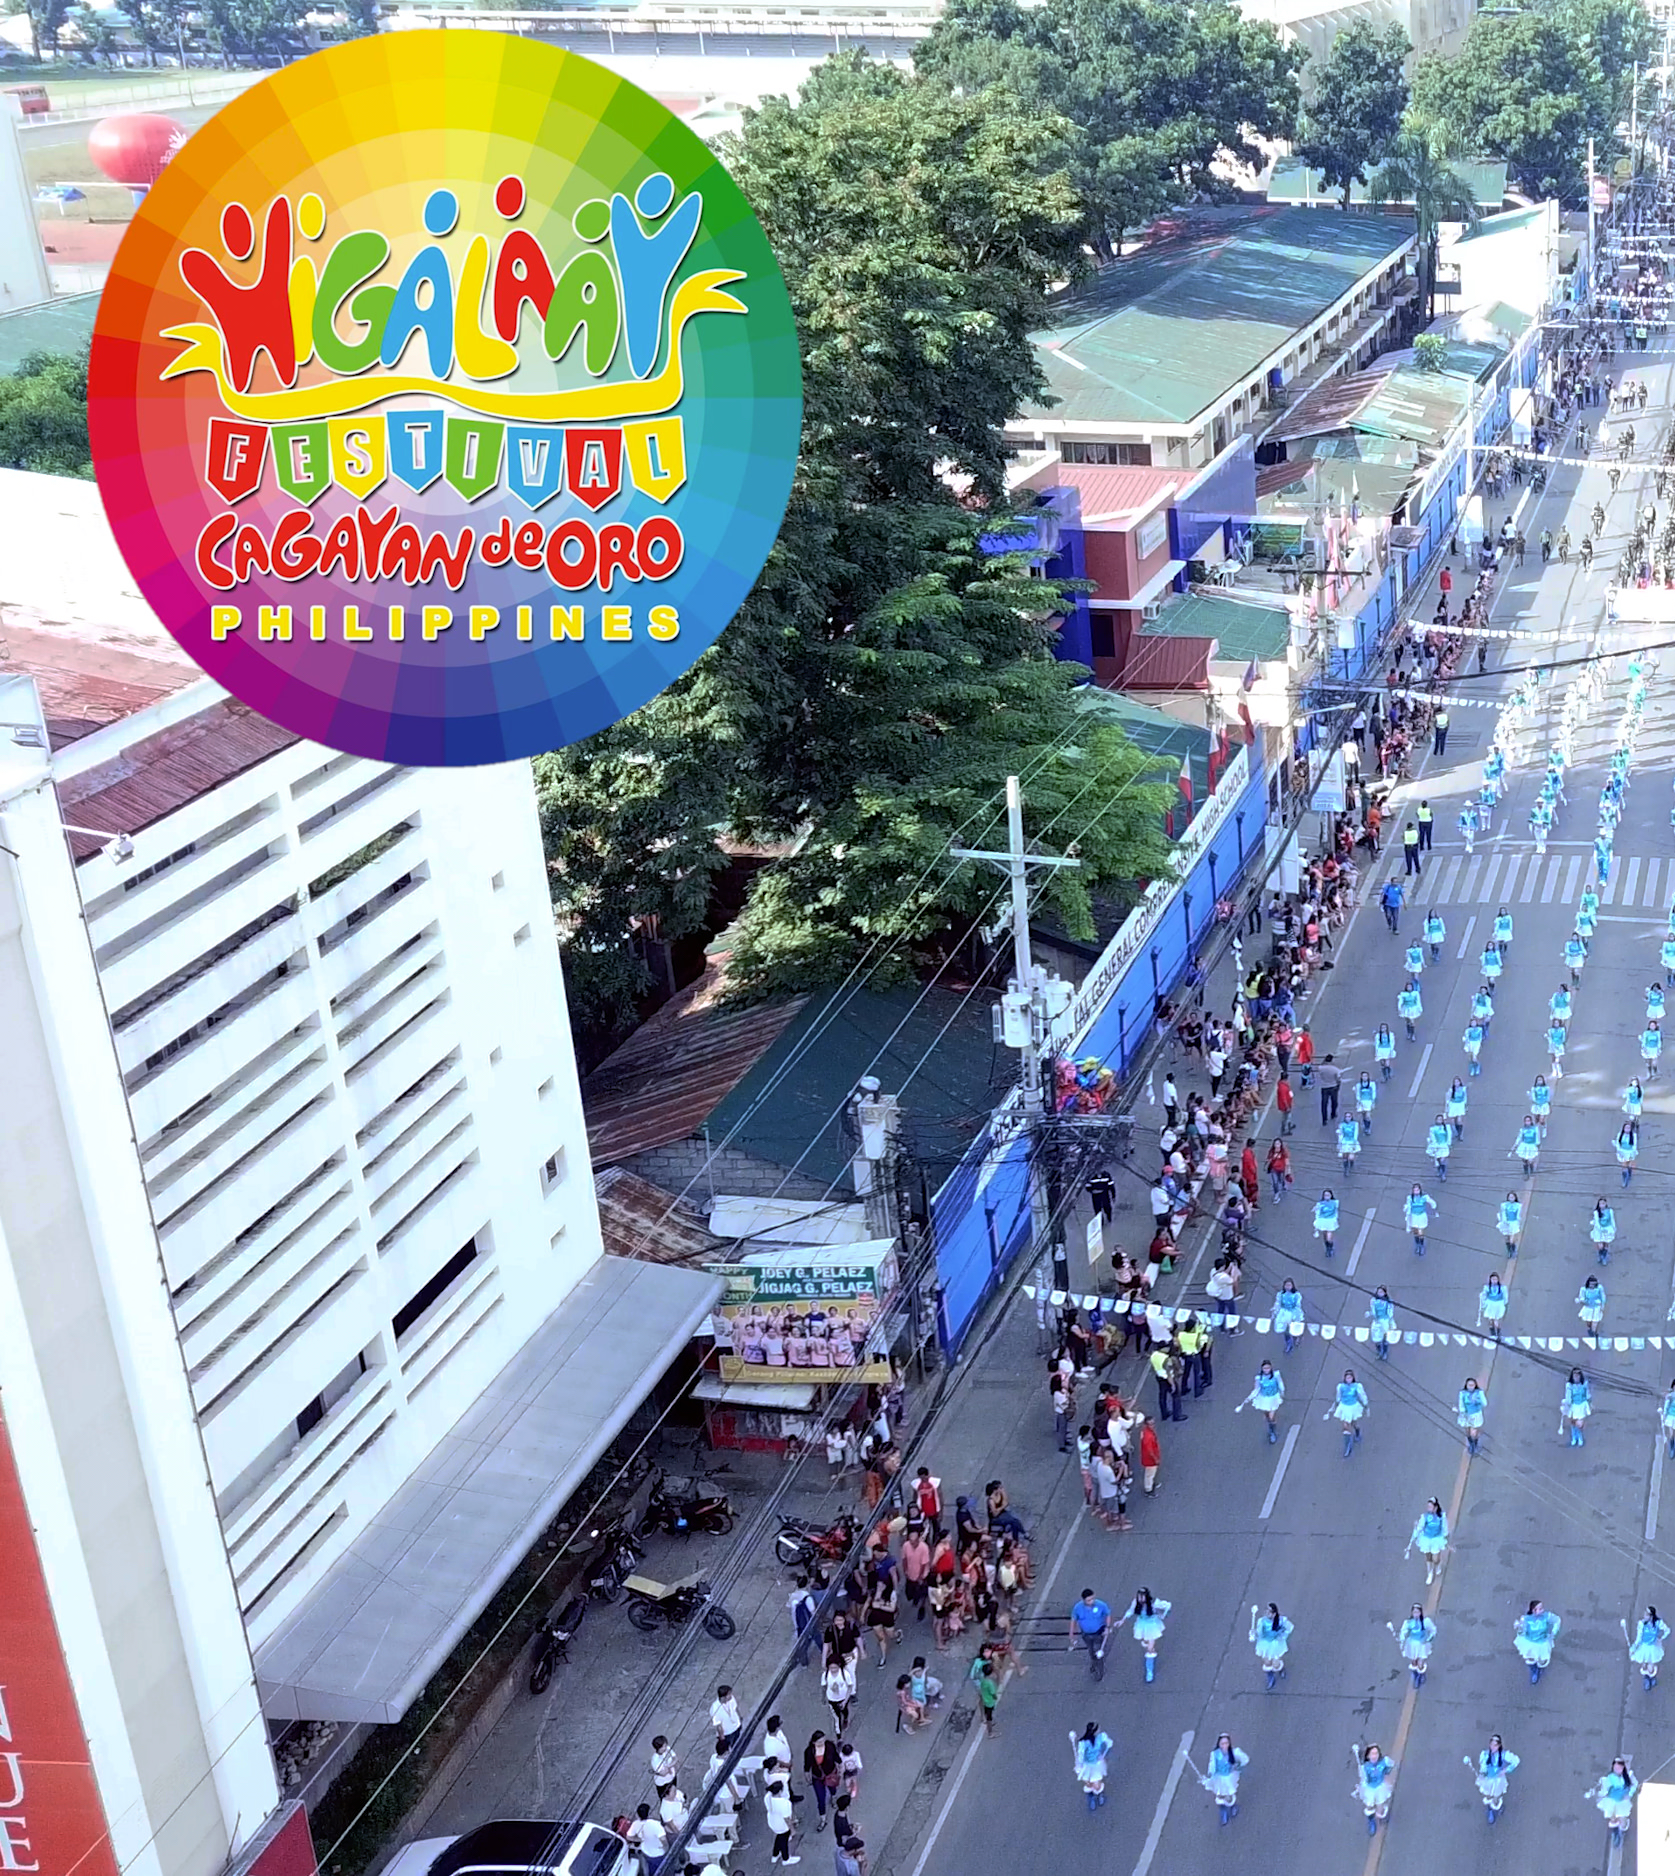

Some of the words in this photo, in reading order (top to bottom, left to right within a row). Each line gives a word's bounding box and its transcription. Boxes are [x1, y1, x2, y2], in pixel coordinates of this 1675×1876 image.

[1091, 930, 1133, 1006] GENERAL
[1201, 802, 1220, 842] HIGH
[1219, 761, 1247, 814] SCHOOL
[760, 1267, 793, 1279] JOEY
[795, 1267, 809, 1279] G.
[812, 1266, 867, 1278] PELAEZ
[758, 1282, 802, 1294] JIGJAG
[805, 1281, 819, 1294] G.
[822, 1281, 874, 1293] PELAEZ
